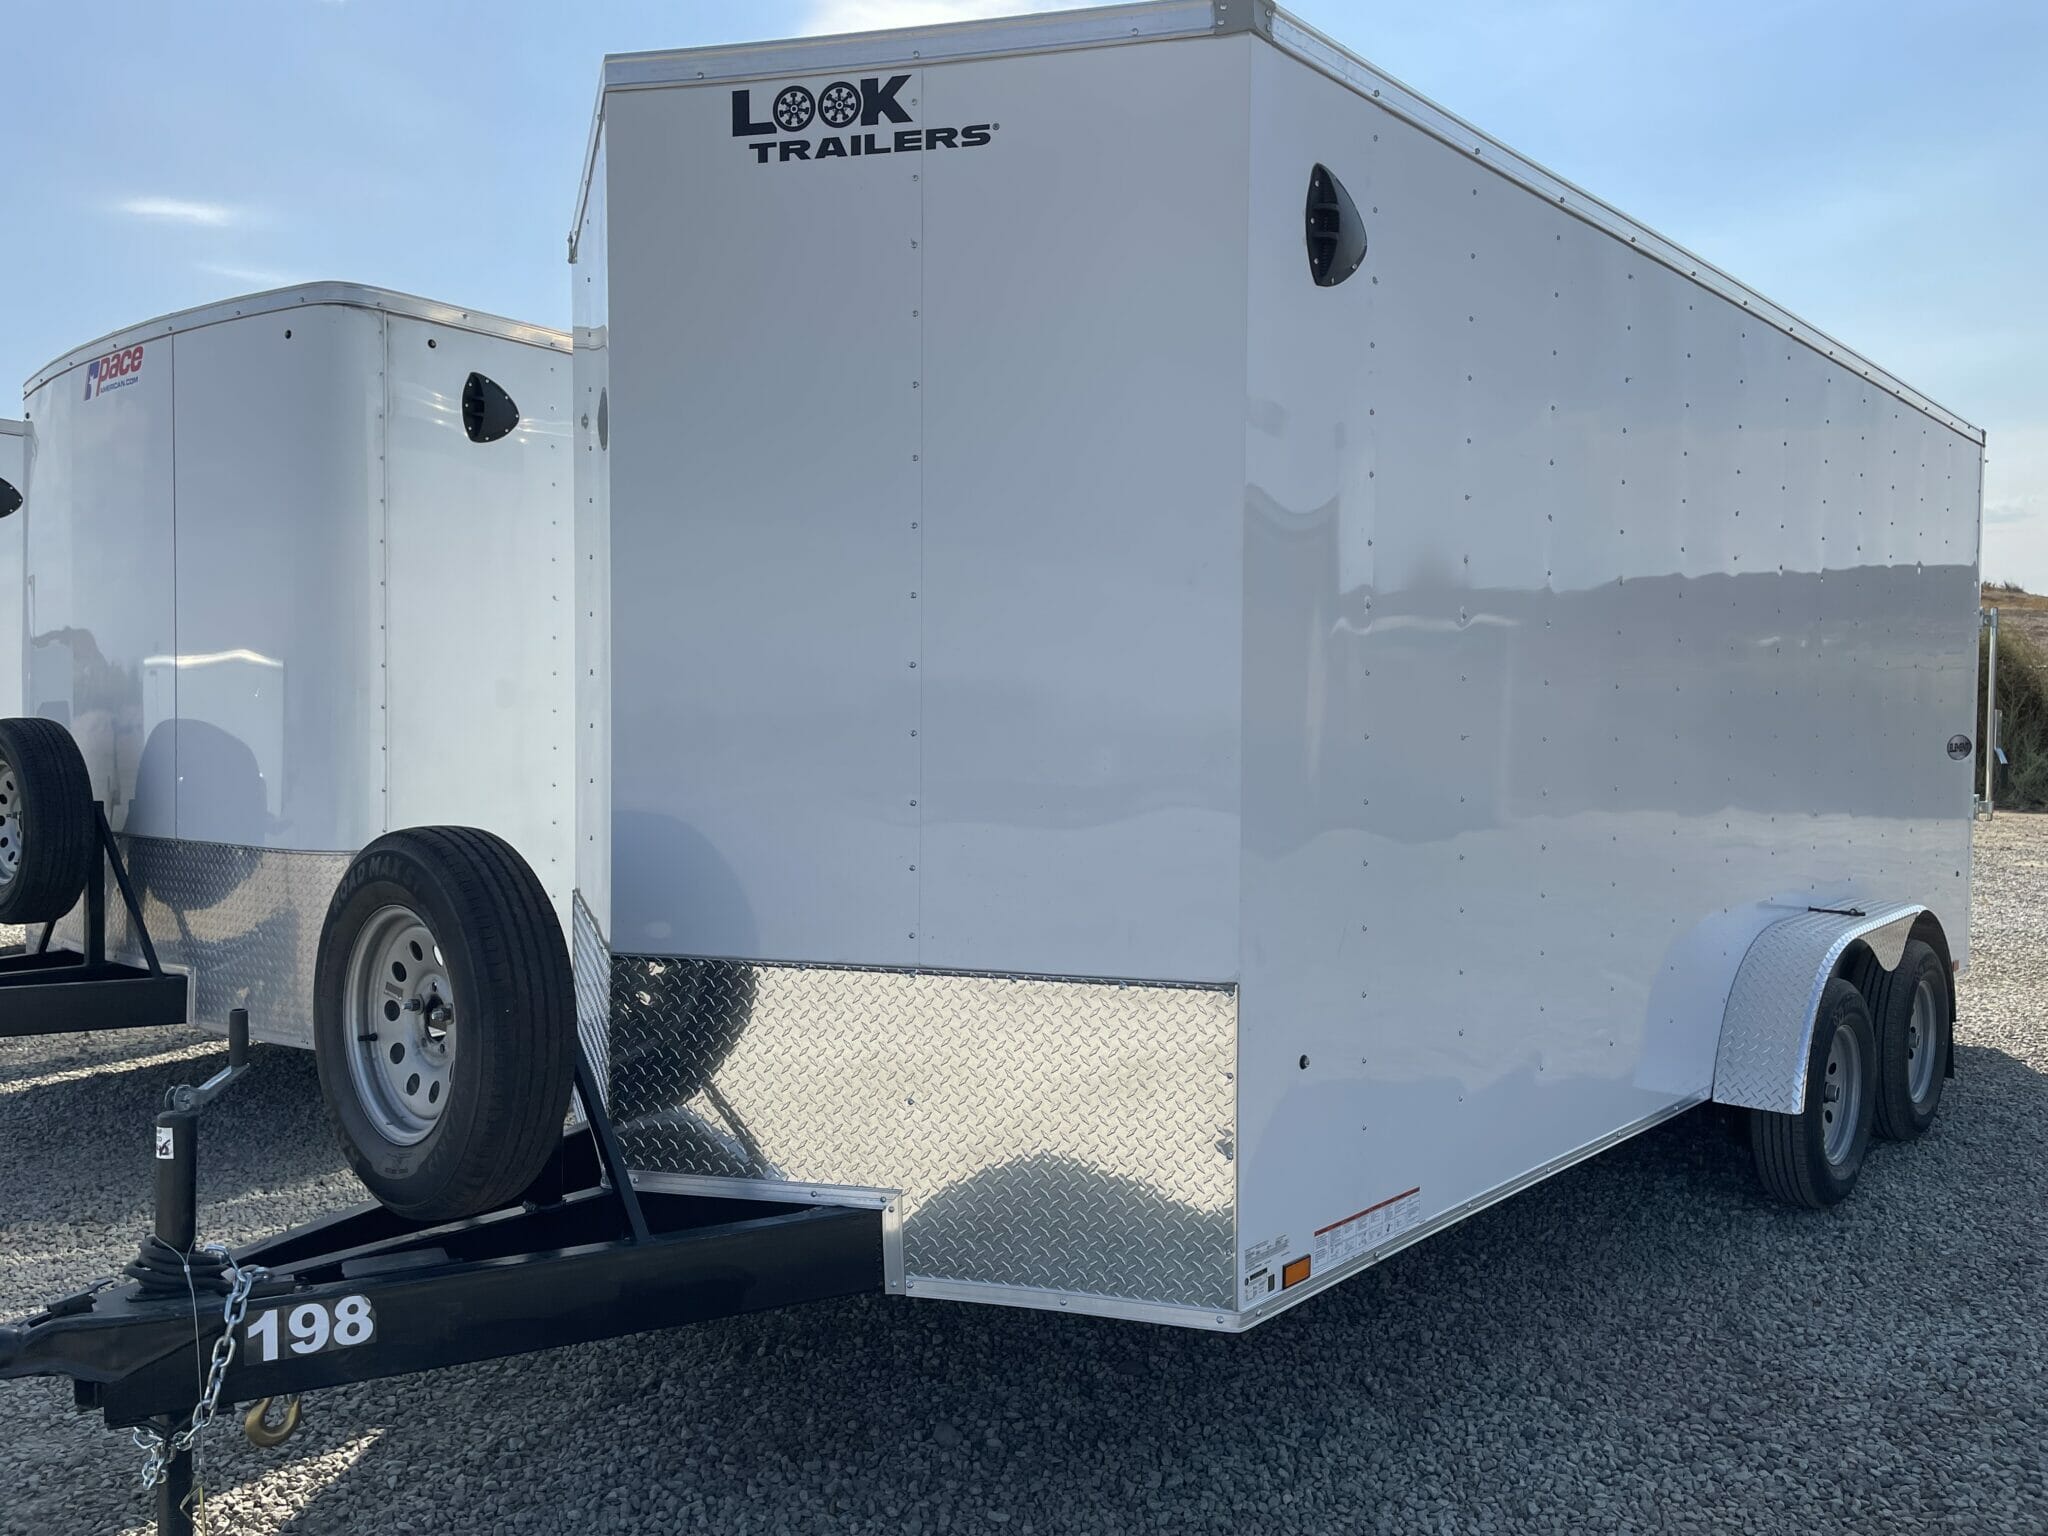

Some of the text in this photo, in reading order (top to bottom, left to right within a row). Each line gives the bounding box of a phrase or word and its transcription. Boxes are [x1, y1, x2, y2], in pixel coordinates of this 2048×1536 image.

[732, 75, 913, 137] LOOK
[749, 124, 991, 164] TRAILERS
[96, 346, 144, 397] pace
[101, 376, 139, 393] AMERICAN.COM
[247, 1295, 374, 1362] 198
